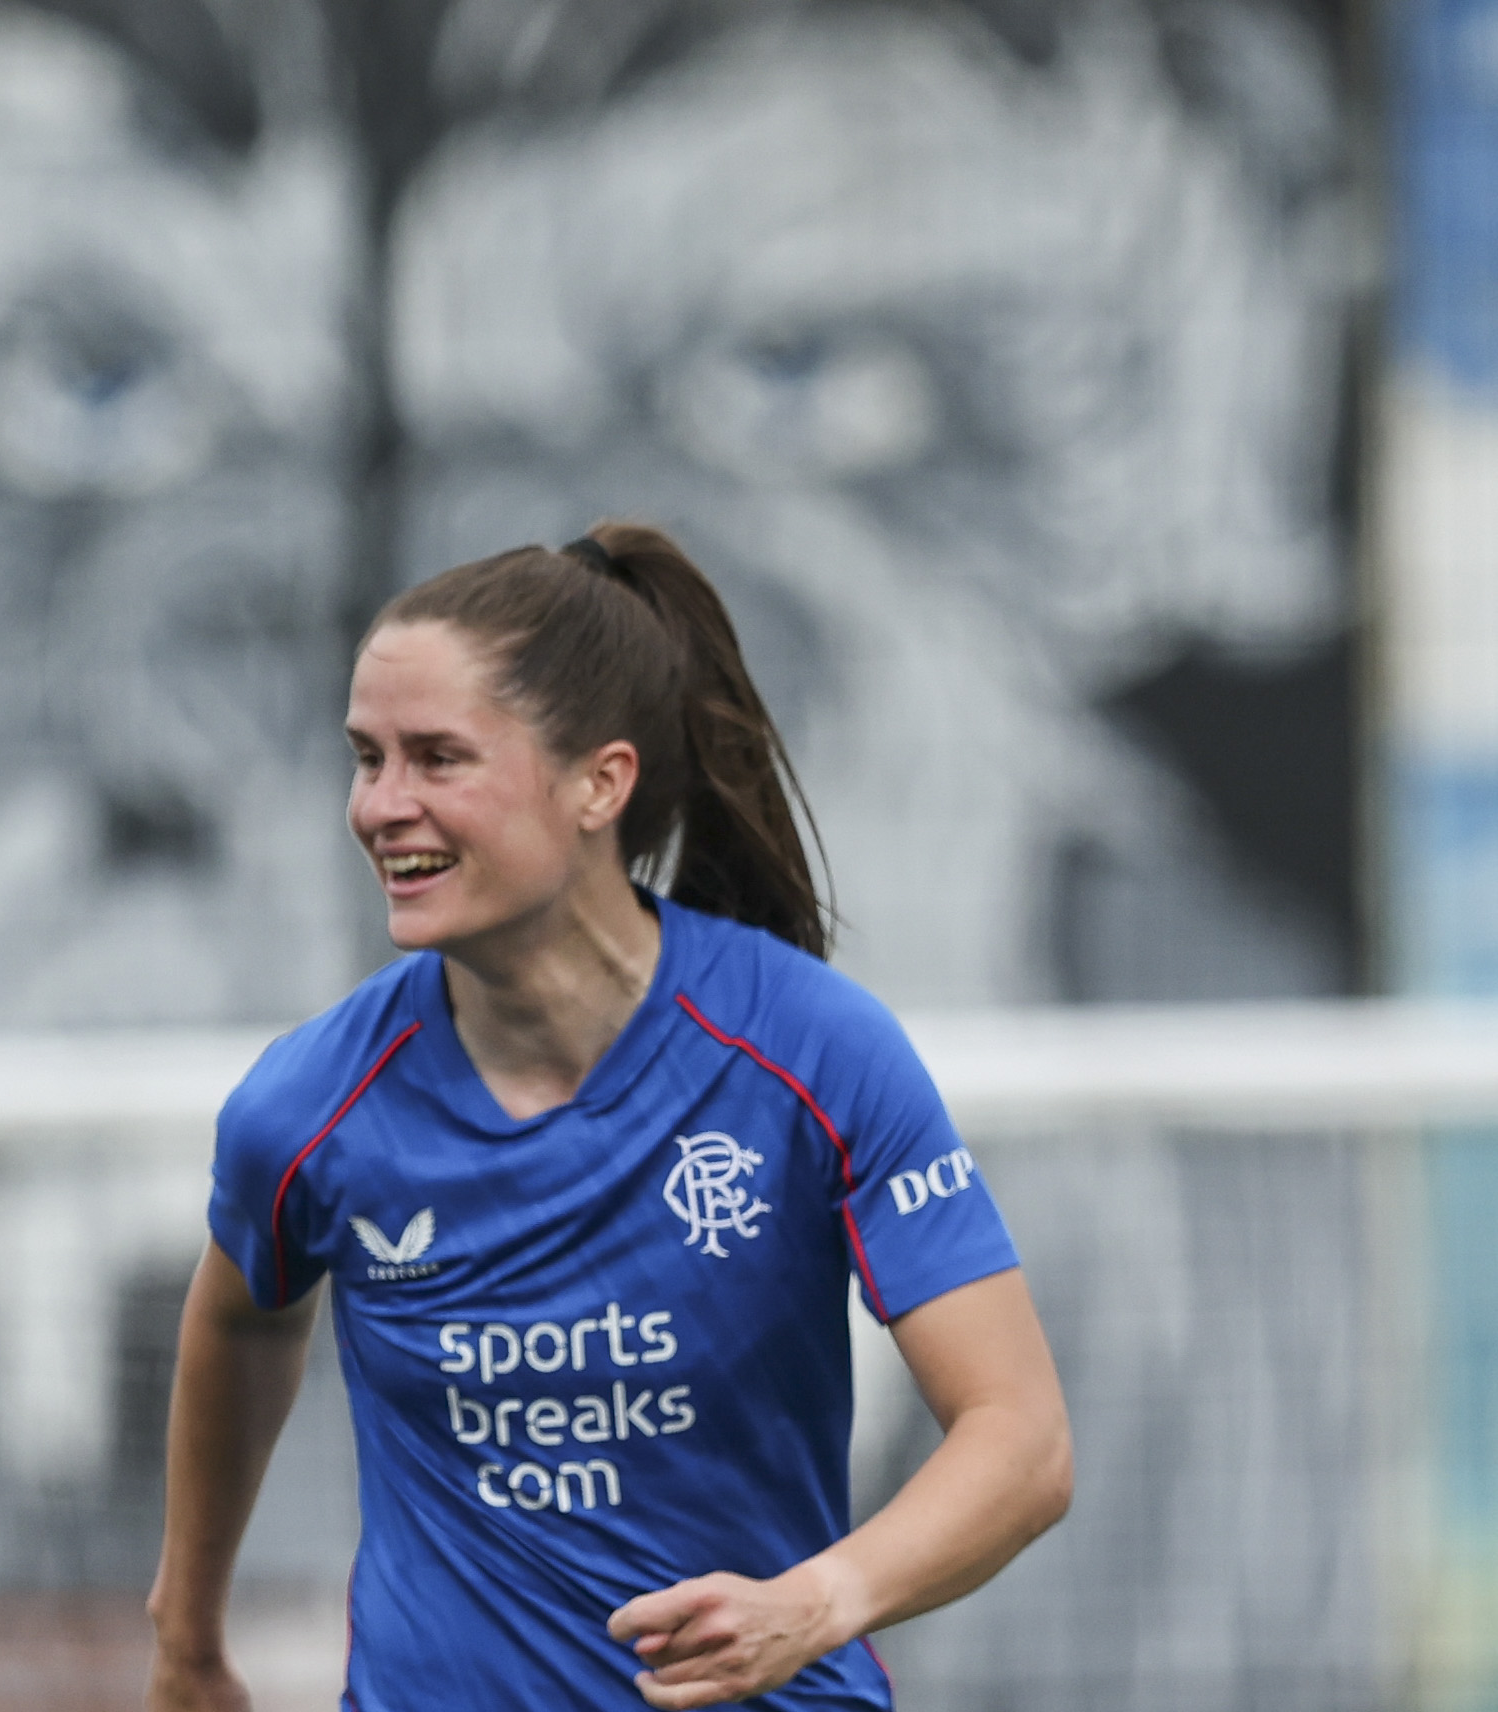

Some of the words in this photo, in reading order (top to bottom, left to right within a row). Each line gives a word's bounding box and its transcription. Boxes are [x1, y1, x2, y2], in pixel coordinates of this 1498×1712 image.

[886, 1146, 974, 1216] DCP
[439, 1301, 678, 1385] sports
[446, 1379, 697, 1447] breaks
